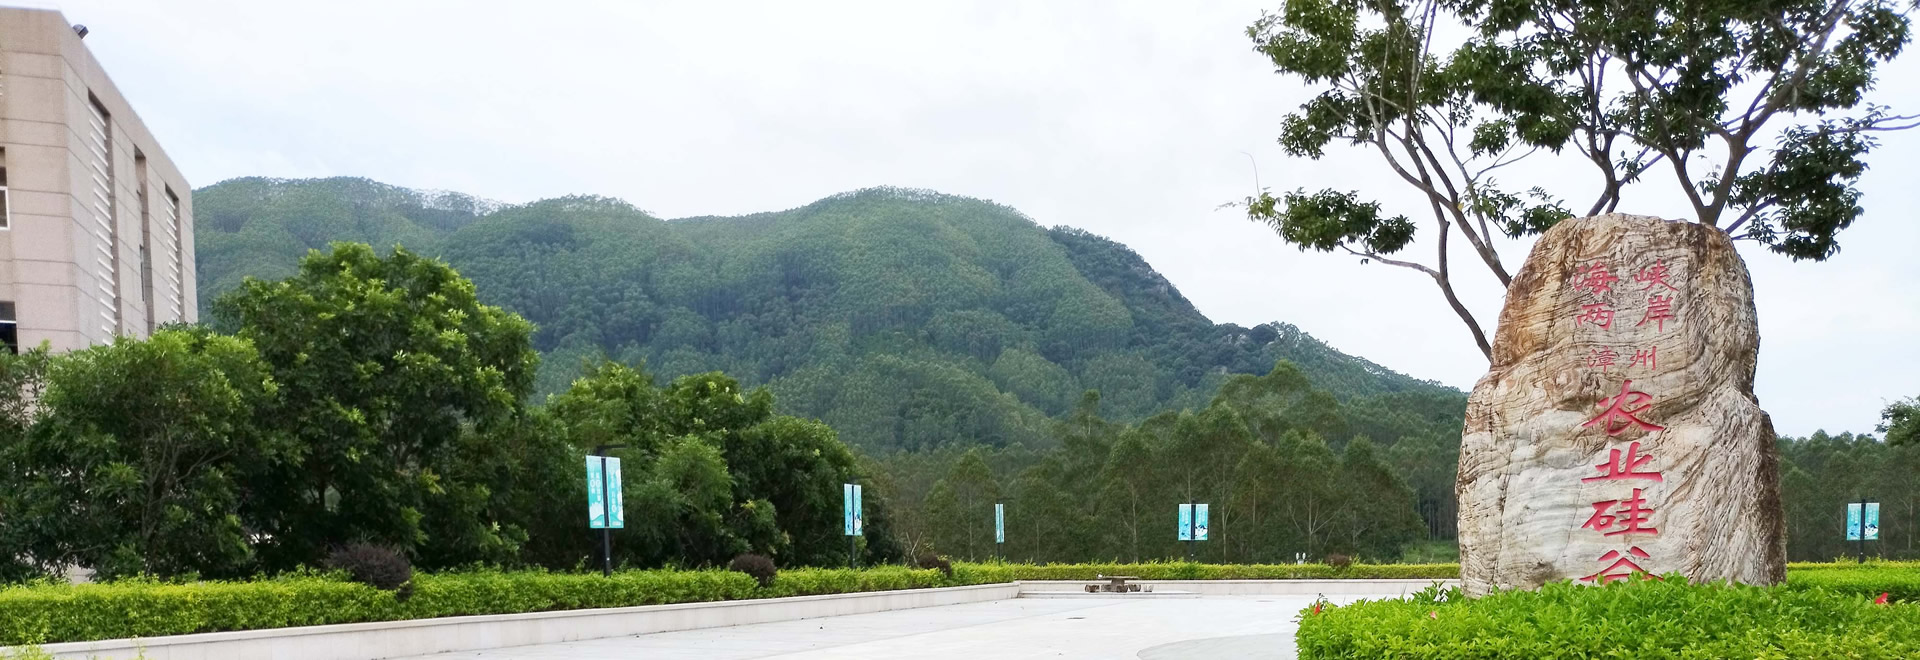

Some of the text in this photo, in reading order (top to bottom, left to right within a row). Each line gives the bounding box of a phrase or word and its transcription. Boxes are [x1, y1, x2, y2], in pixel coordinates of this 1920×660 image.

[1573, 259, 1680, 295] 海峡
[1577, 295, 1675, 332] 两岸
[1586, 345, 1657, 373] 漳州
[1579, 379, 1665, 584] 农业硅谷
